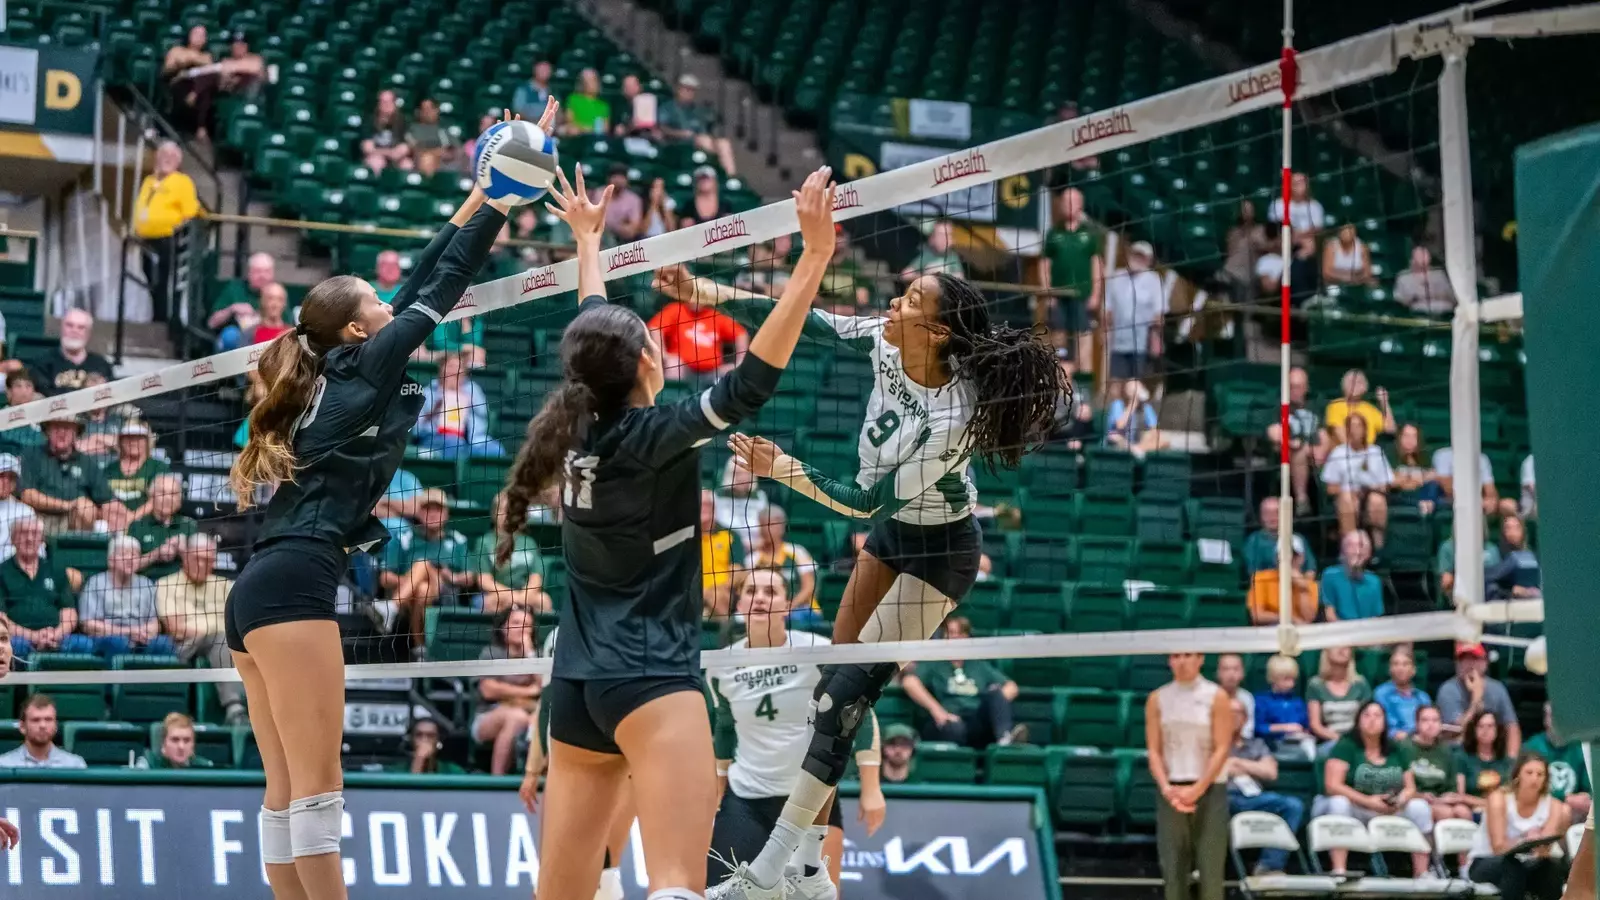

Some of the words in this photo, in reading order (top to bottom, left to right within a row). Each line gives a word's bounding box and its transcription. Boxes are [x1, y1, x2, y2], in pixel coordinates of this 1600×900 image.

[45, 69, 82, 111] D
[1228, 71, 1281, 102] uchea
[1070, 108, 1133, 147] uchealth
[479, 132, 503, 178] molten
[931, 148, 987, 184] uchealth
[831, 184, 860, 210] ealth
[703, 215, 747, 244] uchealth
[607, 241, 647, 269] uchealth
[521, 267, 556, 293] uchealth
[867, 409, 900, 448] 9
[734, 664, 798, 683] COLORADO
[747, 676, 784, 690] STATE
[755, 693, 779, 722] 4
[210, 809, 541, 887] FOKIA
